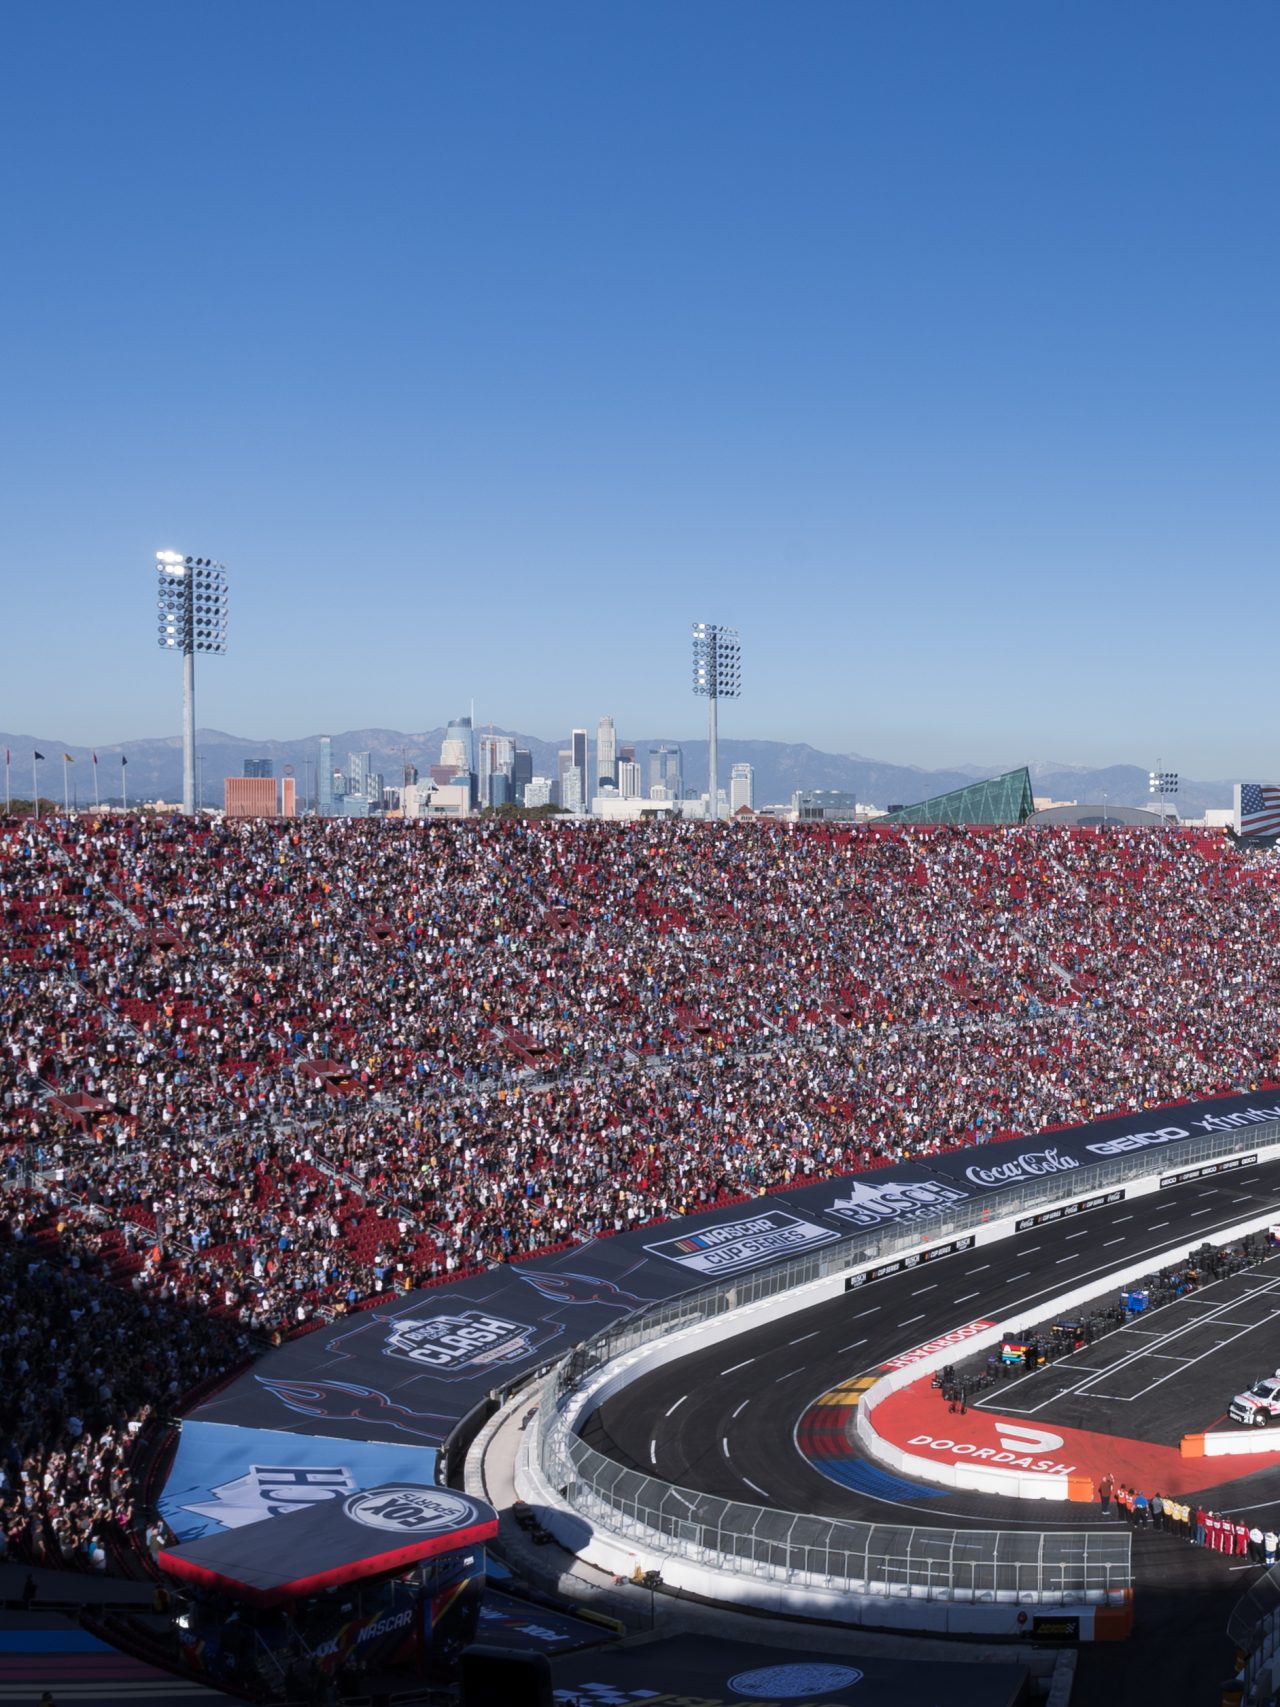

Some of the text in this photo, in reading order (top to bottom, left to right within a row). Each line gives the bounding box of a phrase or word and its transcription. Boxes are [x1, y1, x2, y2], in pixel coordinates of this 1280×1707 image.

[1085, 1126, 1190, 1155] GEICO
[966, 1148, 1081, 1187] Coca-Cola
[1161, 1176, 1177, 1186] GEICO
[1201, 1166, 1217, 1175] GEICO
[1241, 1156, 1257, 1165] GEICO
[824, 1181, 969, 1226] BUSCH
[699, 1218, 778, 1246] NASCAR
[704, 1230, 806, 1265] CUP SERIES
[877, 1267, 887, 1276] CUP
[404, 1321, 453, 1341] BUSCH
[408, 1318, 517, 1364] CLASH
[887, 1323, 989, 1368] DOORDASH
[907, 1435, 1077, 1476] DOORDASH
[359, 1498, 446, 1528] FOX
[396, 1493, 462, 1518] SPORTS
[357, 1609, 414, 1644] NASCAR
